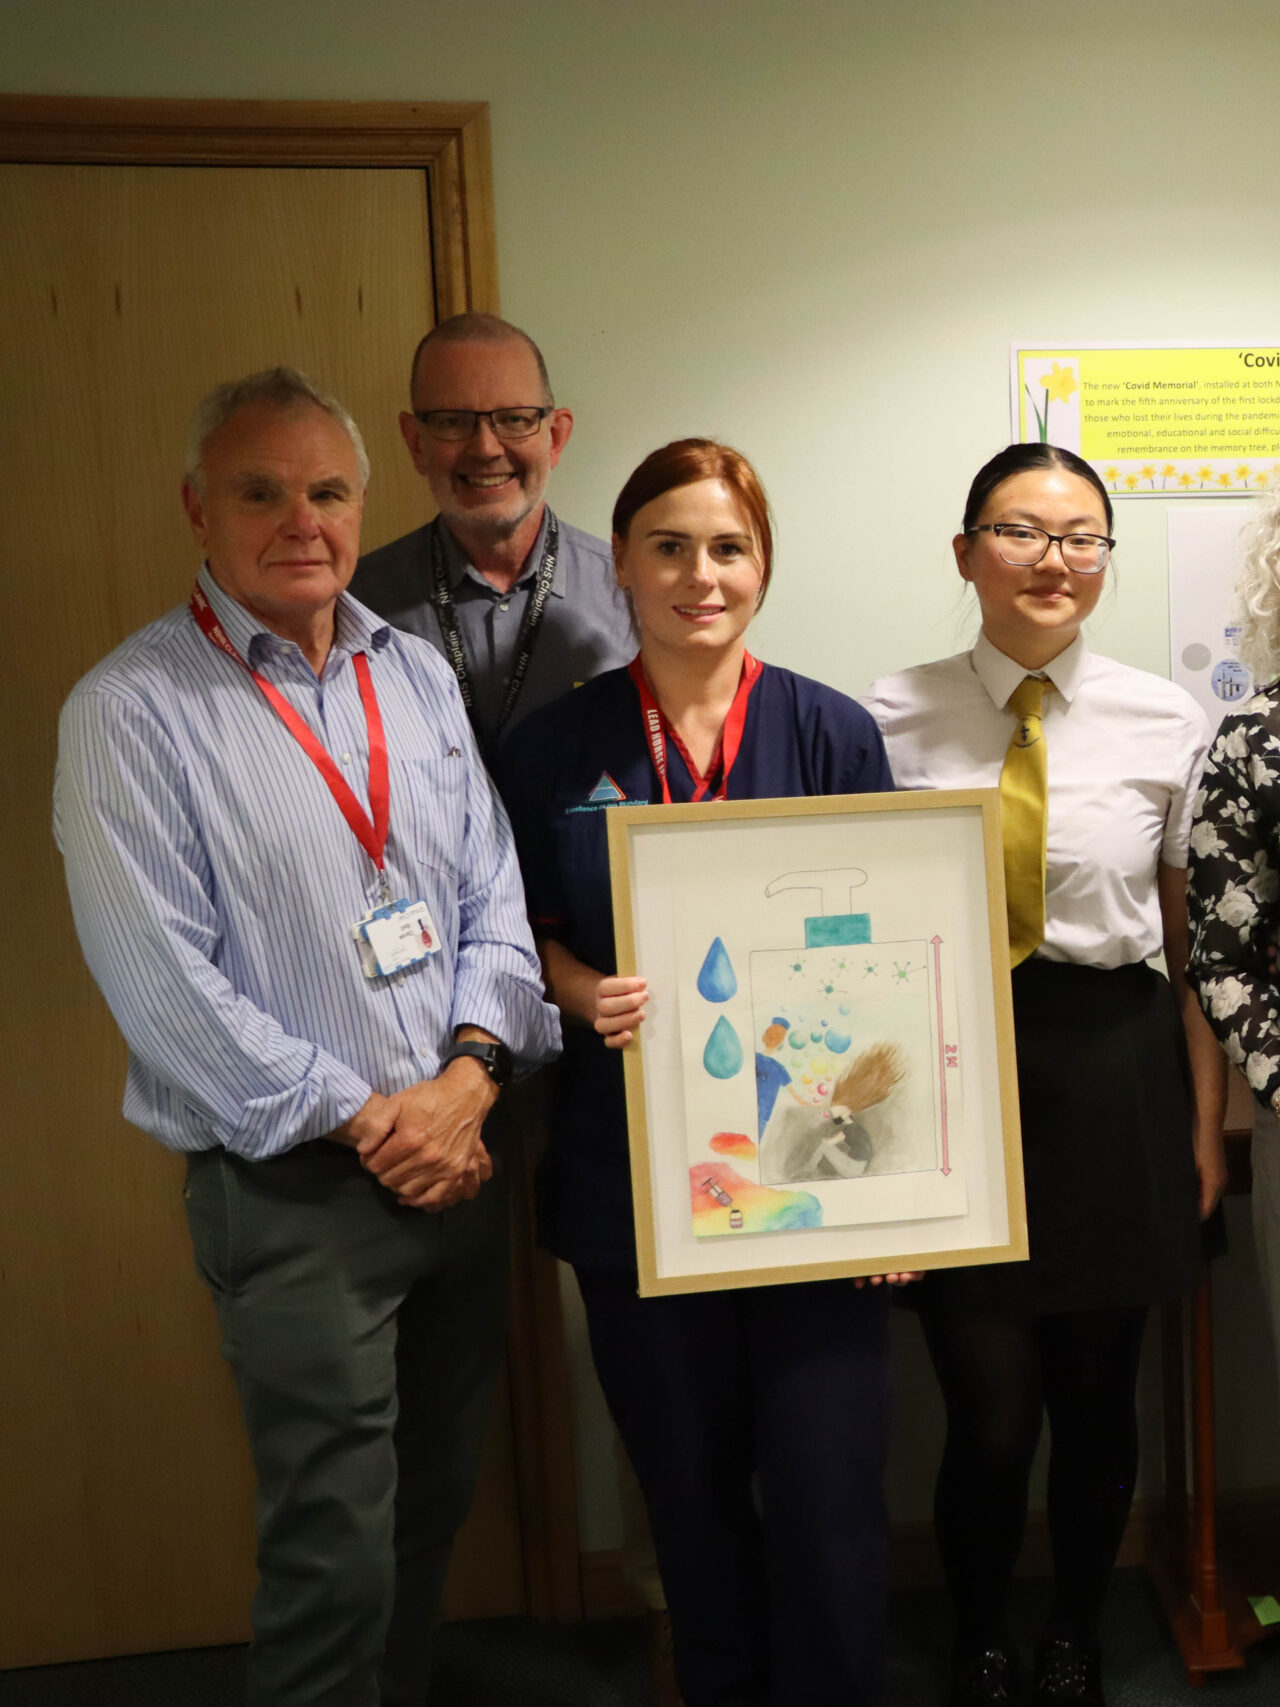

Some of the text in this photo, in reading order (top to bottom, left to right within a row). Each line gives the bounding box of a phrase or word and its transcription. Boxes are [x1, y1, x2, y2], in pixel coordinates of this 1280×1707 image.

[1083, 381, 1099, 390] The
[1203, 380, 1240, 389] installed
[1253, 379, 1273, 388] both
[1097, 397, 1119, 406] mark
[1122, 397, 1136, 406] the
[1138, 397, 1157, 406] fifth
[1159, 397, 1208, 408] anniversary
[1211, 396, 1220, 405] of
[1222, 396, 1237, 405] the
[1239, 396, 1256, 405] first
[1084, 413, 1109, 422] those
[1111, 413, 1131, 422] who
[1133, 413, 1149, 421] lost
[1151, 412, 1171, 421] their
[1173, 412, 1193, 421] lives
[1195, 412, 1223, 423] during
[1225, 411, 1240, 420] the
[1156, 428, 1207, 437] educational
[1209, 427, 1225, 436] and
[1227, 427, 1252, 436] social
[1117, 444, 1178, 454] remembrance
[1194, 443, 1208, 452] the
[1210, 445, 1246, 455] memory
[529, 554, 556, 627] NHS Chaplain
[449, 630, 473, 708] NHS Chaplain
[647, 709, 661, 732] LEAD
[651, 733, 664, 765] NURSE
